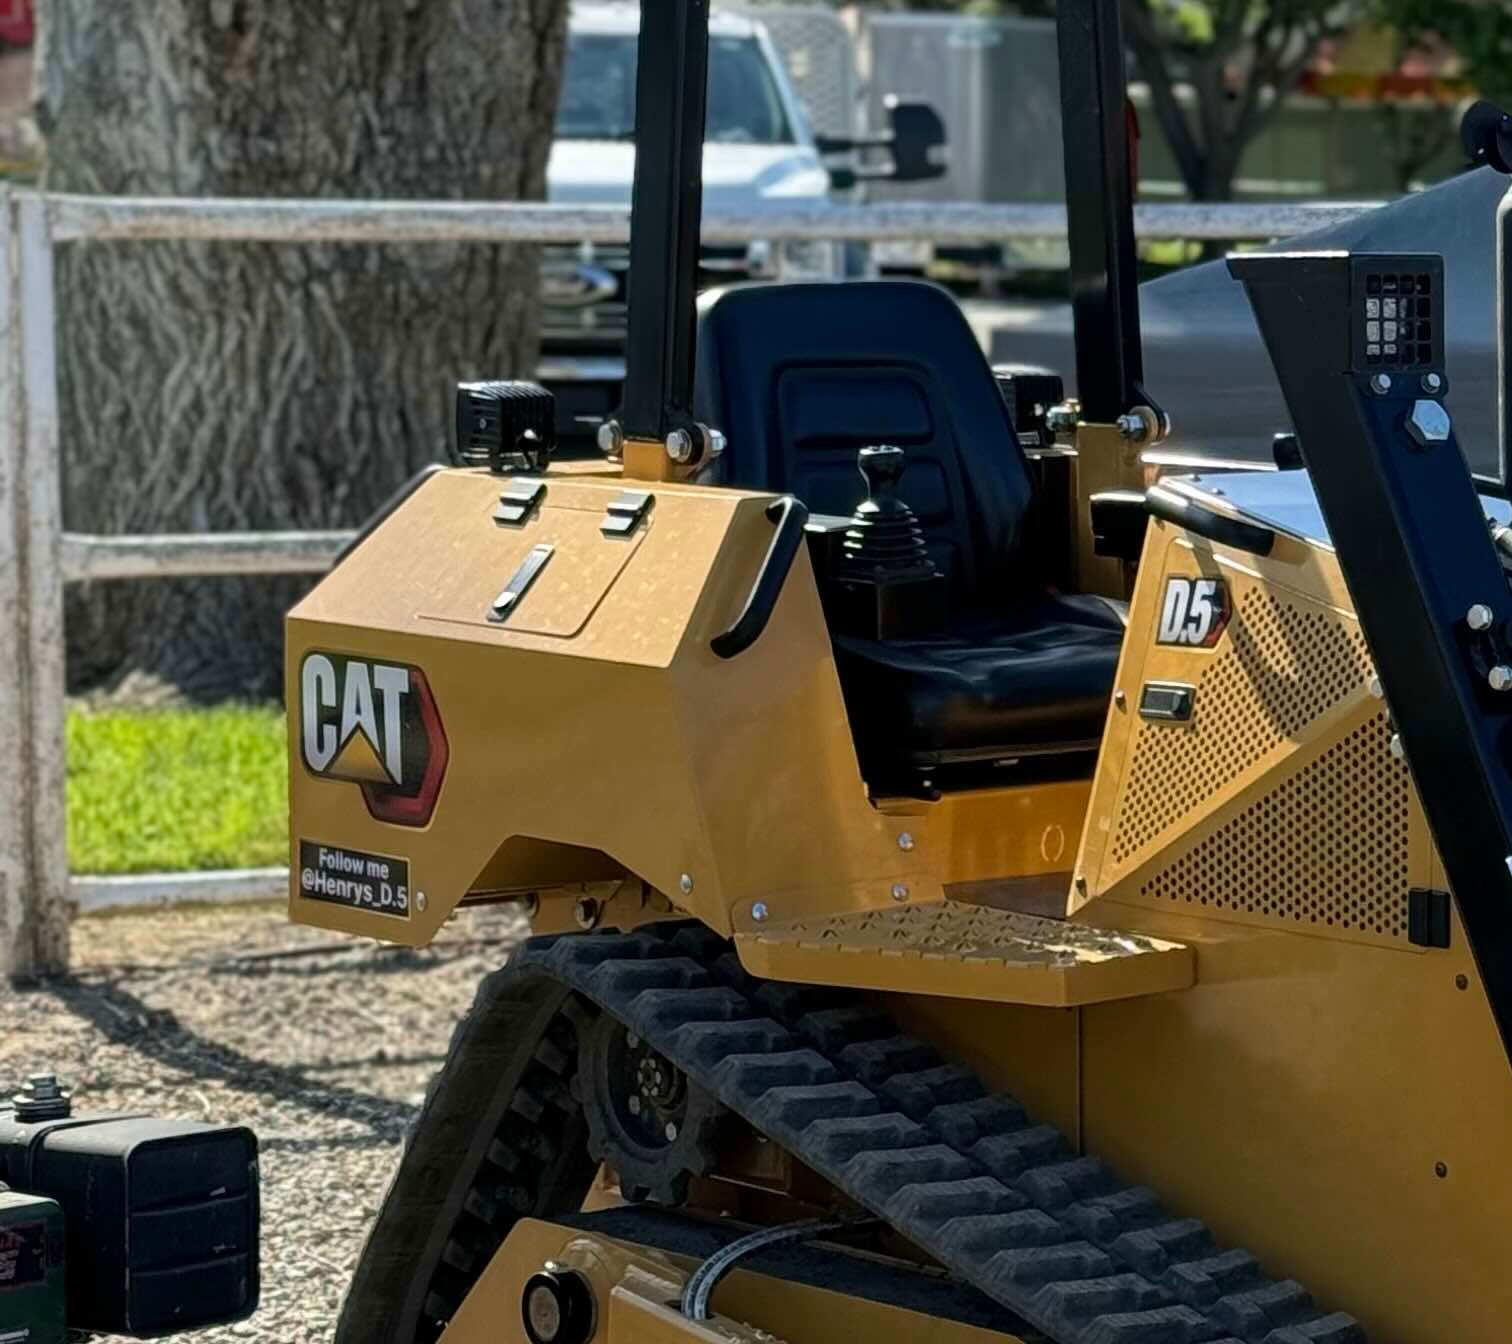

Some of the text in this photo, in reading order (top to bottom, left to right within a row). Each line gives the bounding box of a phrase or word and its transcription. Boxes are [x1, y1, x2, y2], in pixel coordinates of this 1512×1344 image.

[302, 654, 409, 785] CAT
[319, 847, 390, 880] Follow me
[302, 867, 408, 909] @Henrys_D.5
